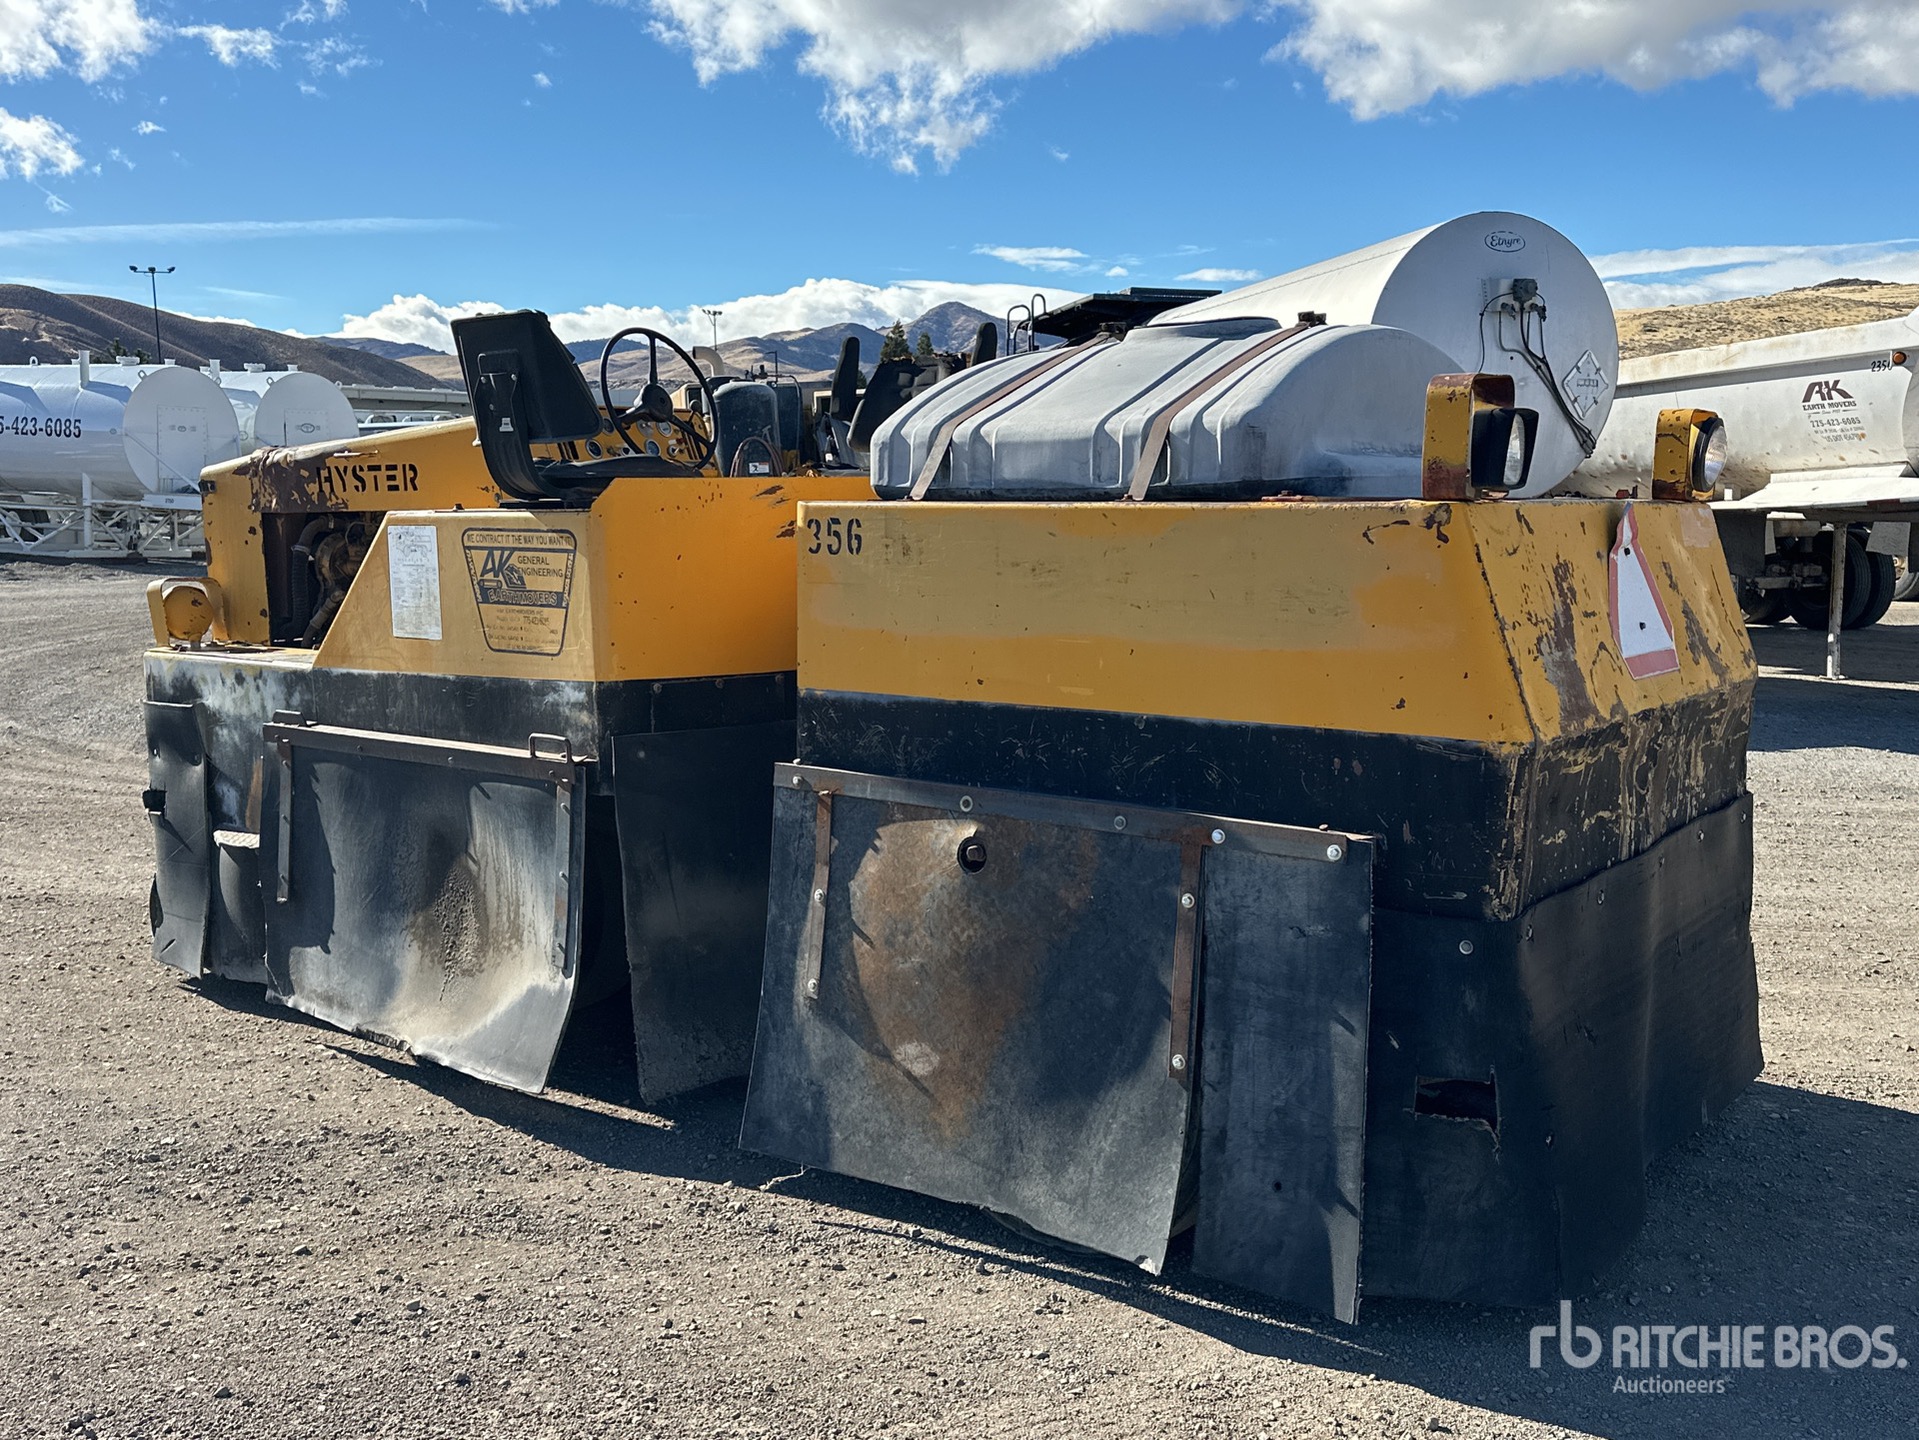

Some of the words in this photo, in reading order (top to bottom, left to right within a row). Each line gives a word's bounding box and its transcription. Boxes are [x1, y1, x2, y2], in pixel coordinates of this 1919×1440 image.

[1802, 403, 1826, 411] EARTH
[1827, 400, 1857, 409] MOVERS
[316, 463, 419, 493] HYSTER
[476, 534, 504, 544] CONTRACT
[511, 535, 522, 545] THE
[523, 536, 535, 545] WAY
[535, 536, 548, 546] YOU
[806, 517, 862, 555] 356
[517, 555, 550, 566] GENERAL
[488, 588, 557, 606] EARTHMOVERS
